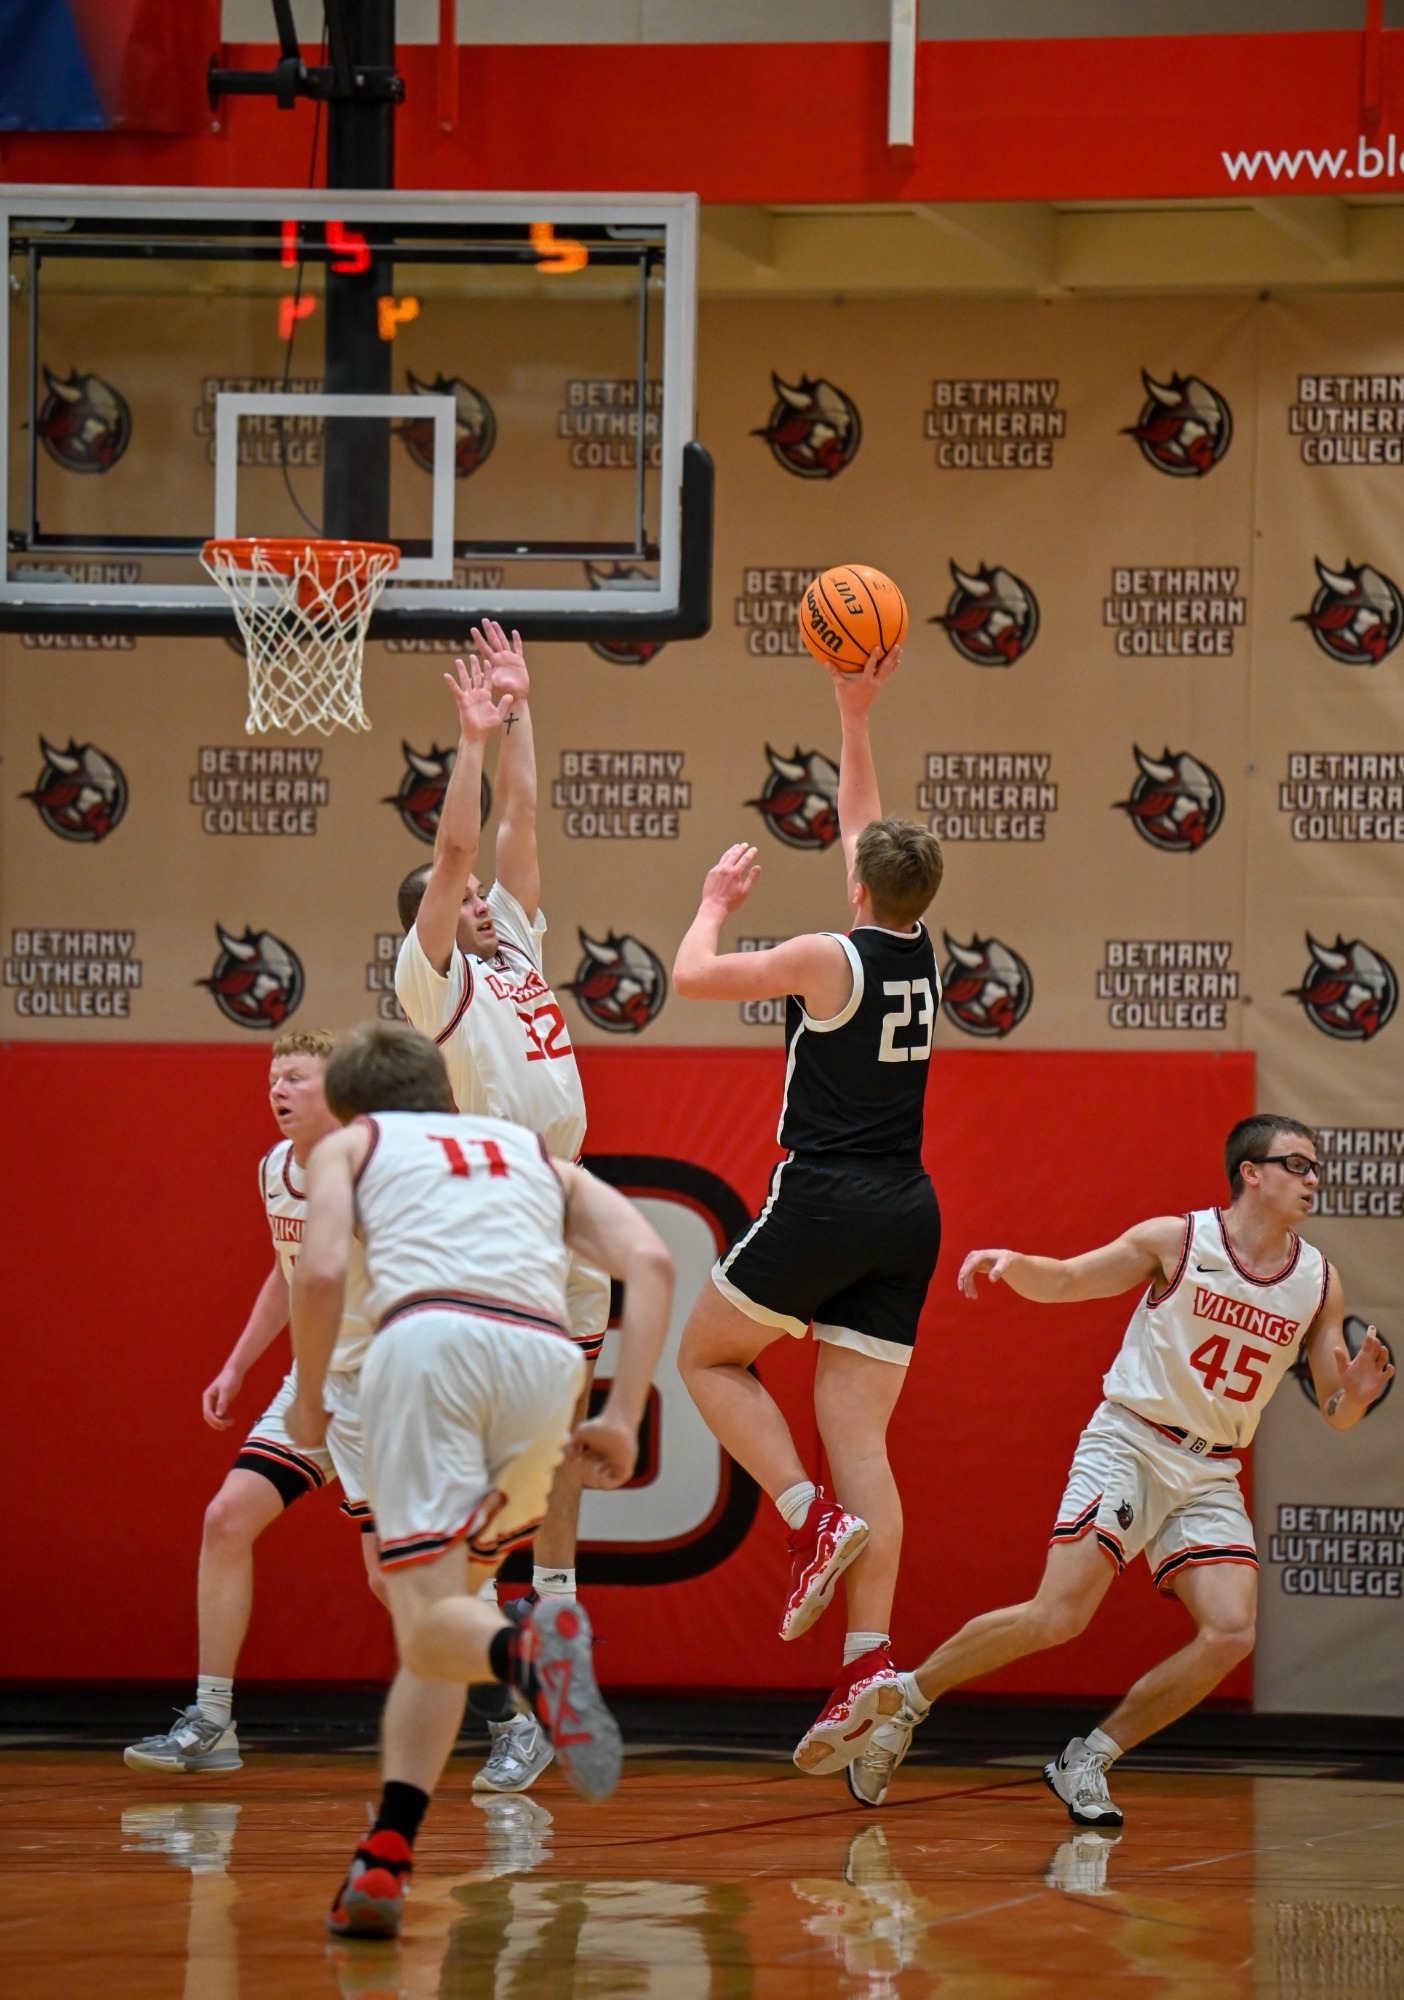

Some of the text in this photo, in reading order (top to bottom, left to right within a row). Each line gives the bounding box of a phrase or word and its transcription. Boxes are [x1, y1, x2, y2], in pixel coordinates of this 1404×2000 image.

[1221, 133, 1404, 181] www.bl
[935, 381, 1058, 406] BETHANY
[1300, 378, 1404, 402] BETHAN
[926, 412, 1063, 437] LUTHERAN
[1291, 408, 1404, 433] LUTHER
[938, 443, 1052, 467] COLLEGE
[1303, 438, 1404, 463] COLLEG
[746, 569, 814, 595] BETH
[1114, 569, 1237, 595] BETHANY
[806, 587, 844, 653] Wilson
[1105, 600, 1244, 625] LUTHERAN
[1117, 630, 1232, 655] COLLEGE
[201, 750, 320, 774] BETHANY
[563, 752, 682, 777] BETHANY
[928, 755, 1048, 780] BETHANY
[192, 780, 328, 804] LUTHERAN
[554, 782, 690, 807] LUTHERAN
[919, 785, 1056, 810] LUTHERAN
[1281, 785, 1404, 811] LUTHERA
[203, 808, 315, 833] COLLEGE
[565, 812, 678, 837] COLLEGE
[931, 815, 1043, 840] COLLEGE
[14, 931, 132, 957] BETHANY
[1108, 942, 1230, 967] BETHANY
[5, 960, 140, 986] LUTHERAN
[1099, 973, 1237, 998] LUTHERAN
[16, 990, 128, 1016] COLLEGE
[1111, 1003, 1226, 1028] COLLEGE
[878, 977, 934, 1062] 23
[1319, 1129, 1404, 1155] THANY
[425, 1132, 510, 1179] 11
[1193, 1287, 1300, 1347] VIKINGS
[1190, 1334, 1272, 1402] 45
[1190, 1437, 1207, 1454] B
[1280, 1505, 1404, 1534] BETHANY
[1283, 1567, 1401, 1597] COLLEGE
